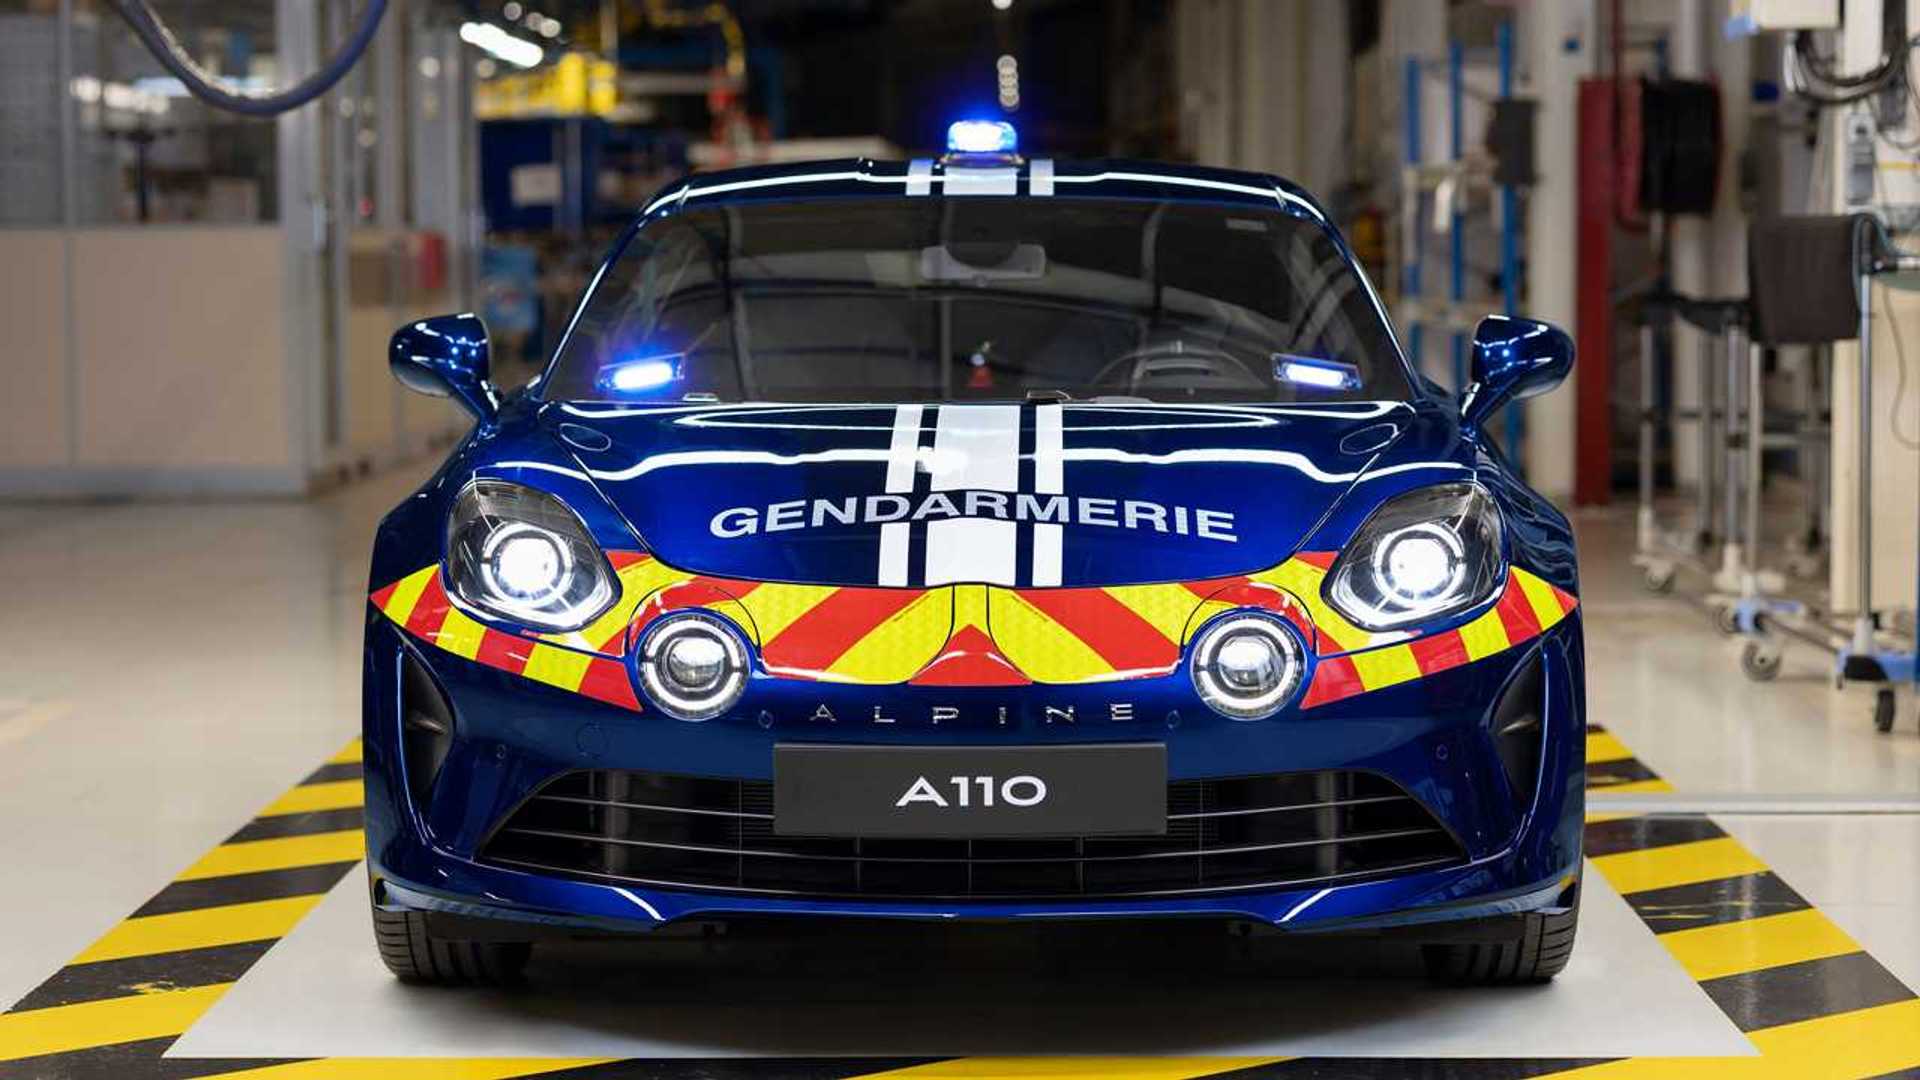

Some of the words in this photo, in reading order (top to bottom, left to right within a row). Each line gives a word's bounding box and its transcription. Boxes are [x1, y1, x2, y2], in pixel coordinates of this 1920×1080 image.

[709, 490, 1239, 543] GENDARMERIE
[809, 703, 1134, 725] ALPINE
[895, 775, 1048, 807] A110
